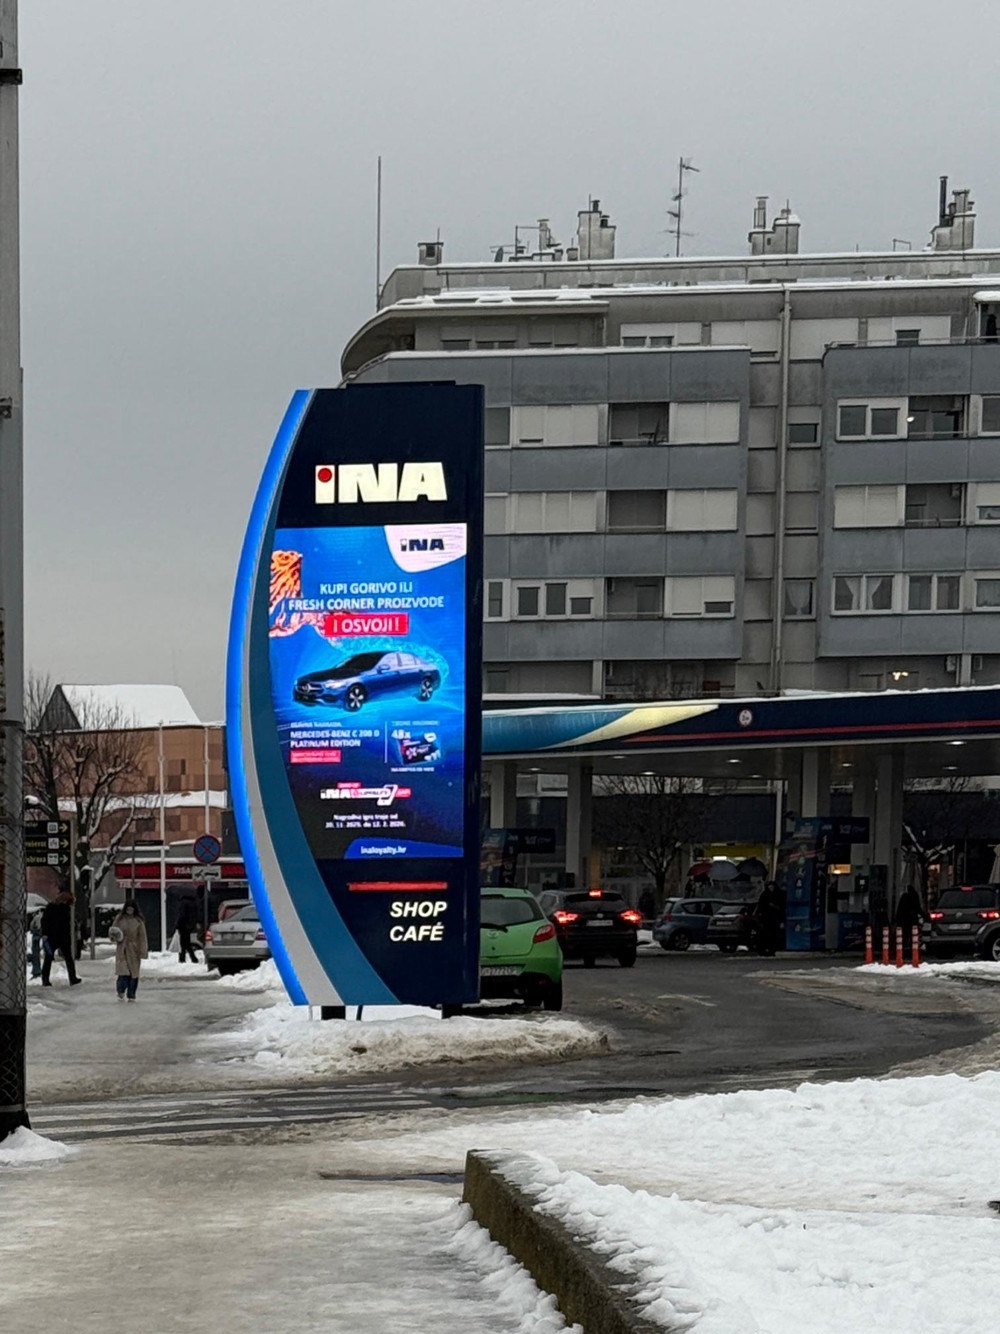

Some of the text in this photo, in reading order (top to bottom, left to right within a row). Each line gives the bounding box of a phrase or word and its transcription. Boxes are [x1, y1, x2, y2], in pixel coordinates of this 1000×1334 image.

[320, 581, 413, 594] KUPI GORIVO ILI
[289, 597, 444, 610] FRESH CORNER PROIZVODE
[290, 730, 350, 738] MERCEDES-BENZ
[290, 739, 361, 748] PLATINUM EDITION
[173, 867, 193, 875] TISA
[390, 901, 447, 918] SHOP
[390, 921, 444, 942] CAFÉ
